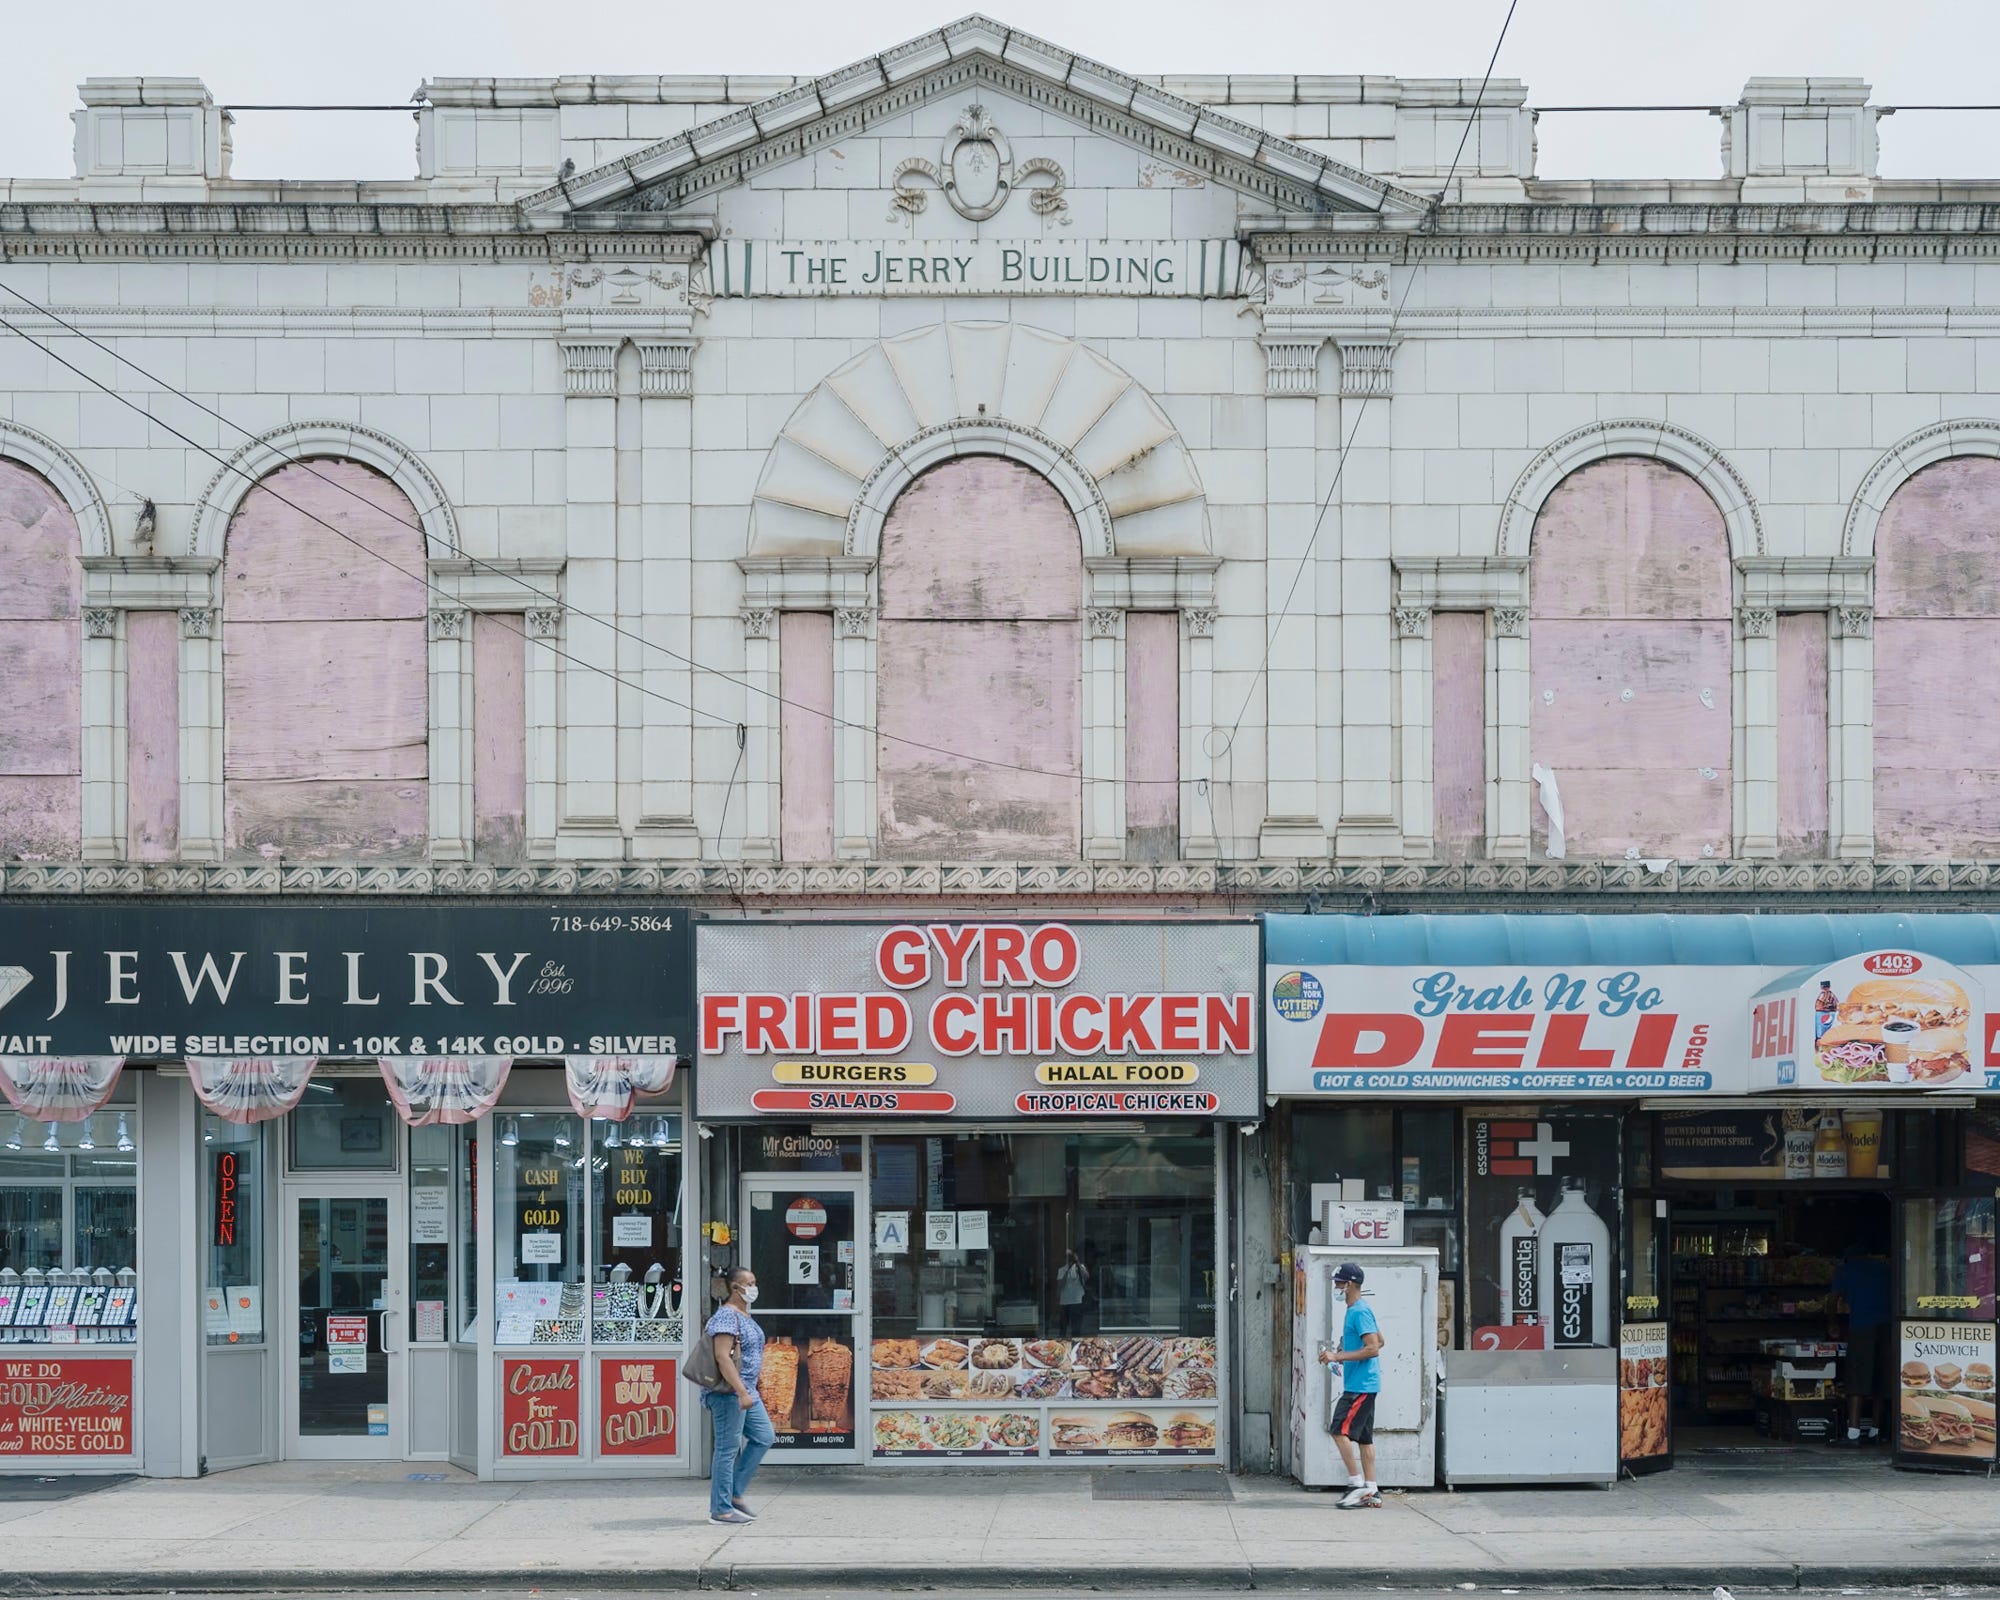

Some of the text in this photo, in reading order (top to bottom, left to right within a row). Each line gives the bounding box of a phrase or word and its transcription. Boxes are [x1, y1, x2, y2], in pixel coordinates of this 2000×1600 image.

[781, 249, 1176, 284] THE JERRY BUILDING
[550, 916, 673, 932] 718-649-5864
[877, 924, 1080, 988] GYRO
[1872, 955, 1914, 969] 1403
[540, 960, 566, 978] Est.
[46, 950, 532, 1021] JEWELRY
[527, 978, 575, 995] 1996
[1302, 981, 1320, 990] NEW
[1303, 990, 1322, 999] YORK
[1413, 971, 1664, 1017] Grab N Go
[1276, 999, 1320, 1011] LOTTERY
[1284, 1011, 1313, 1020] GAMES
[702, 993, 1253, 1055] FRIED CHICKEN
[1750, 997, 1796, 1060] DELI
[0, 1035, 52, 1053] AIT
[109, 1035, 677, 1055] WIDE SELECTION 10K & 14K GOLD SILVER
[1311, 1013, 1679, 1069] DELI
[800, 1065, 907, 1081] BURGERS
[1047, 1065, 1185, 1081] HALAL FOOD
[1319, 1075, 1707, 1088] HOT & COLD SANDWICHES COFFEE TEA COLD BEER
[809, 1093, 899, 1109] SALADS
[1026, 1094, 1210, 1110] TROPICAL CHICKEN
[762, 1135, 834, 1151] Mr Grillooo
[1475, 1122, 1488, 1176] essentia
[623, 1150, 645, 1165] WE
[779, 1150, 814, 1159] Rockaway
[524, 1169, 559, 1185] CASH
[620, 1169, 648, 1185] BUY
[221, 1154, 236, 1245] OPEN
[537, 1188, 546, 1205] 4
[616, 1189, 652, 1205] GOLD
[523, 1209, 560, 1225] GOLD
[882, 1222, 902, 1244] A
[1343, 1220, 1390, 1240] ICE
[1516, 1240, 1532, 1308] essentia
[1622, 1327, 1666, 1343] SOLD HERE
[1904, 1325, 1992, 1341] SOLD HERE
[6, 1363, 62, 1377] WE DO
[620, 1364, 656, 1382] WE
[509, 1363, 575, 1395] Cash
[22, 1381, 129, 1416] Plating
[614, 1382, 663, 1404] BUY
[1, 1419, 14, 1433] in
[604, 1405, 675, 1447] GOLD
[0, 1434, 125, 1451] and ROSE GOLD
[508, 1419, 578, 1453] GOLD
[779, 1435, 795, 1444] GYRO
[812, 1436, 845, 1444] LAMB GYRO
